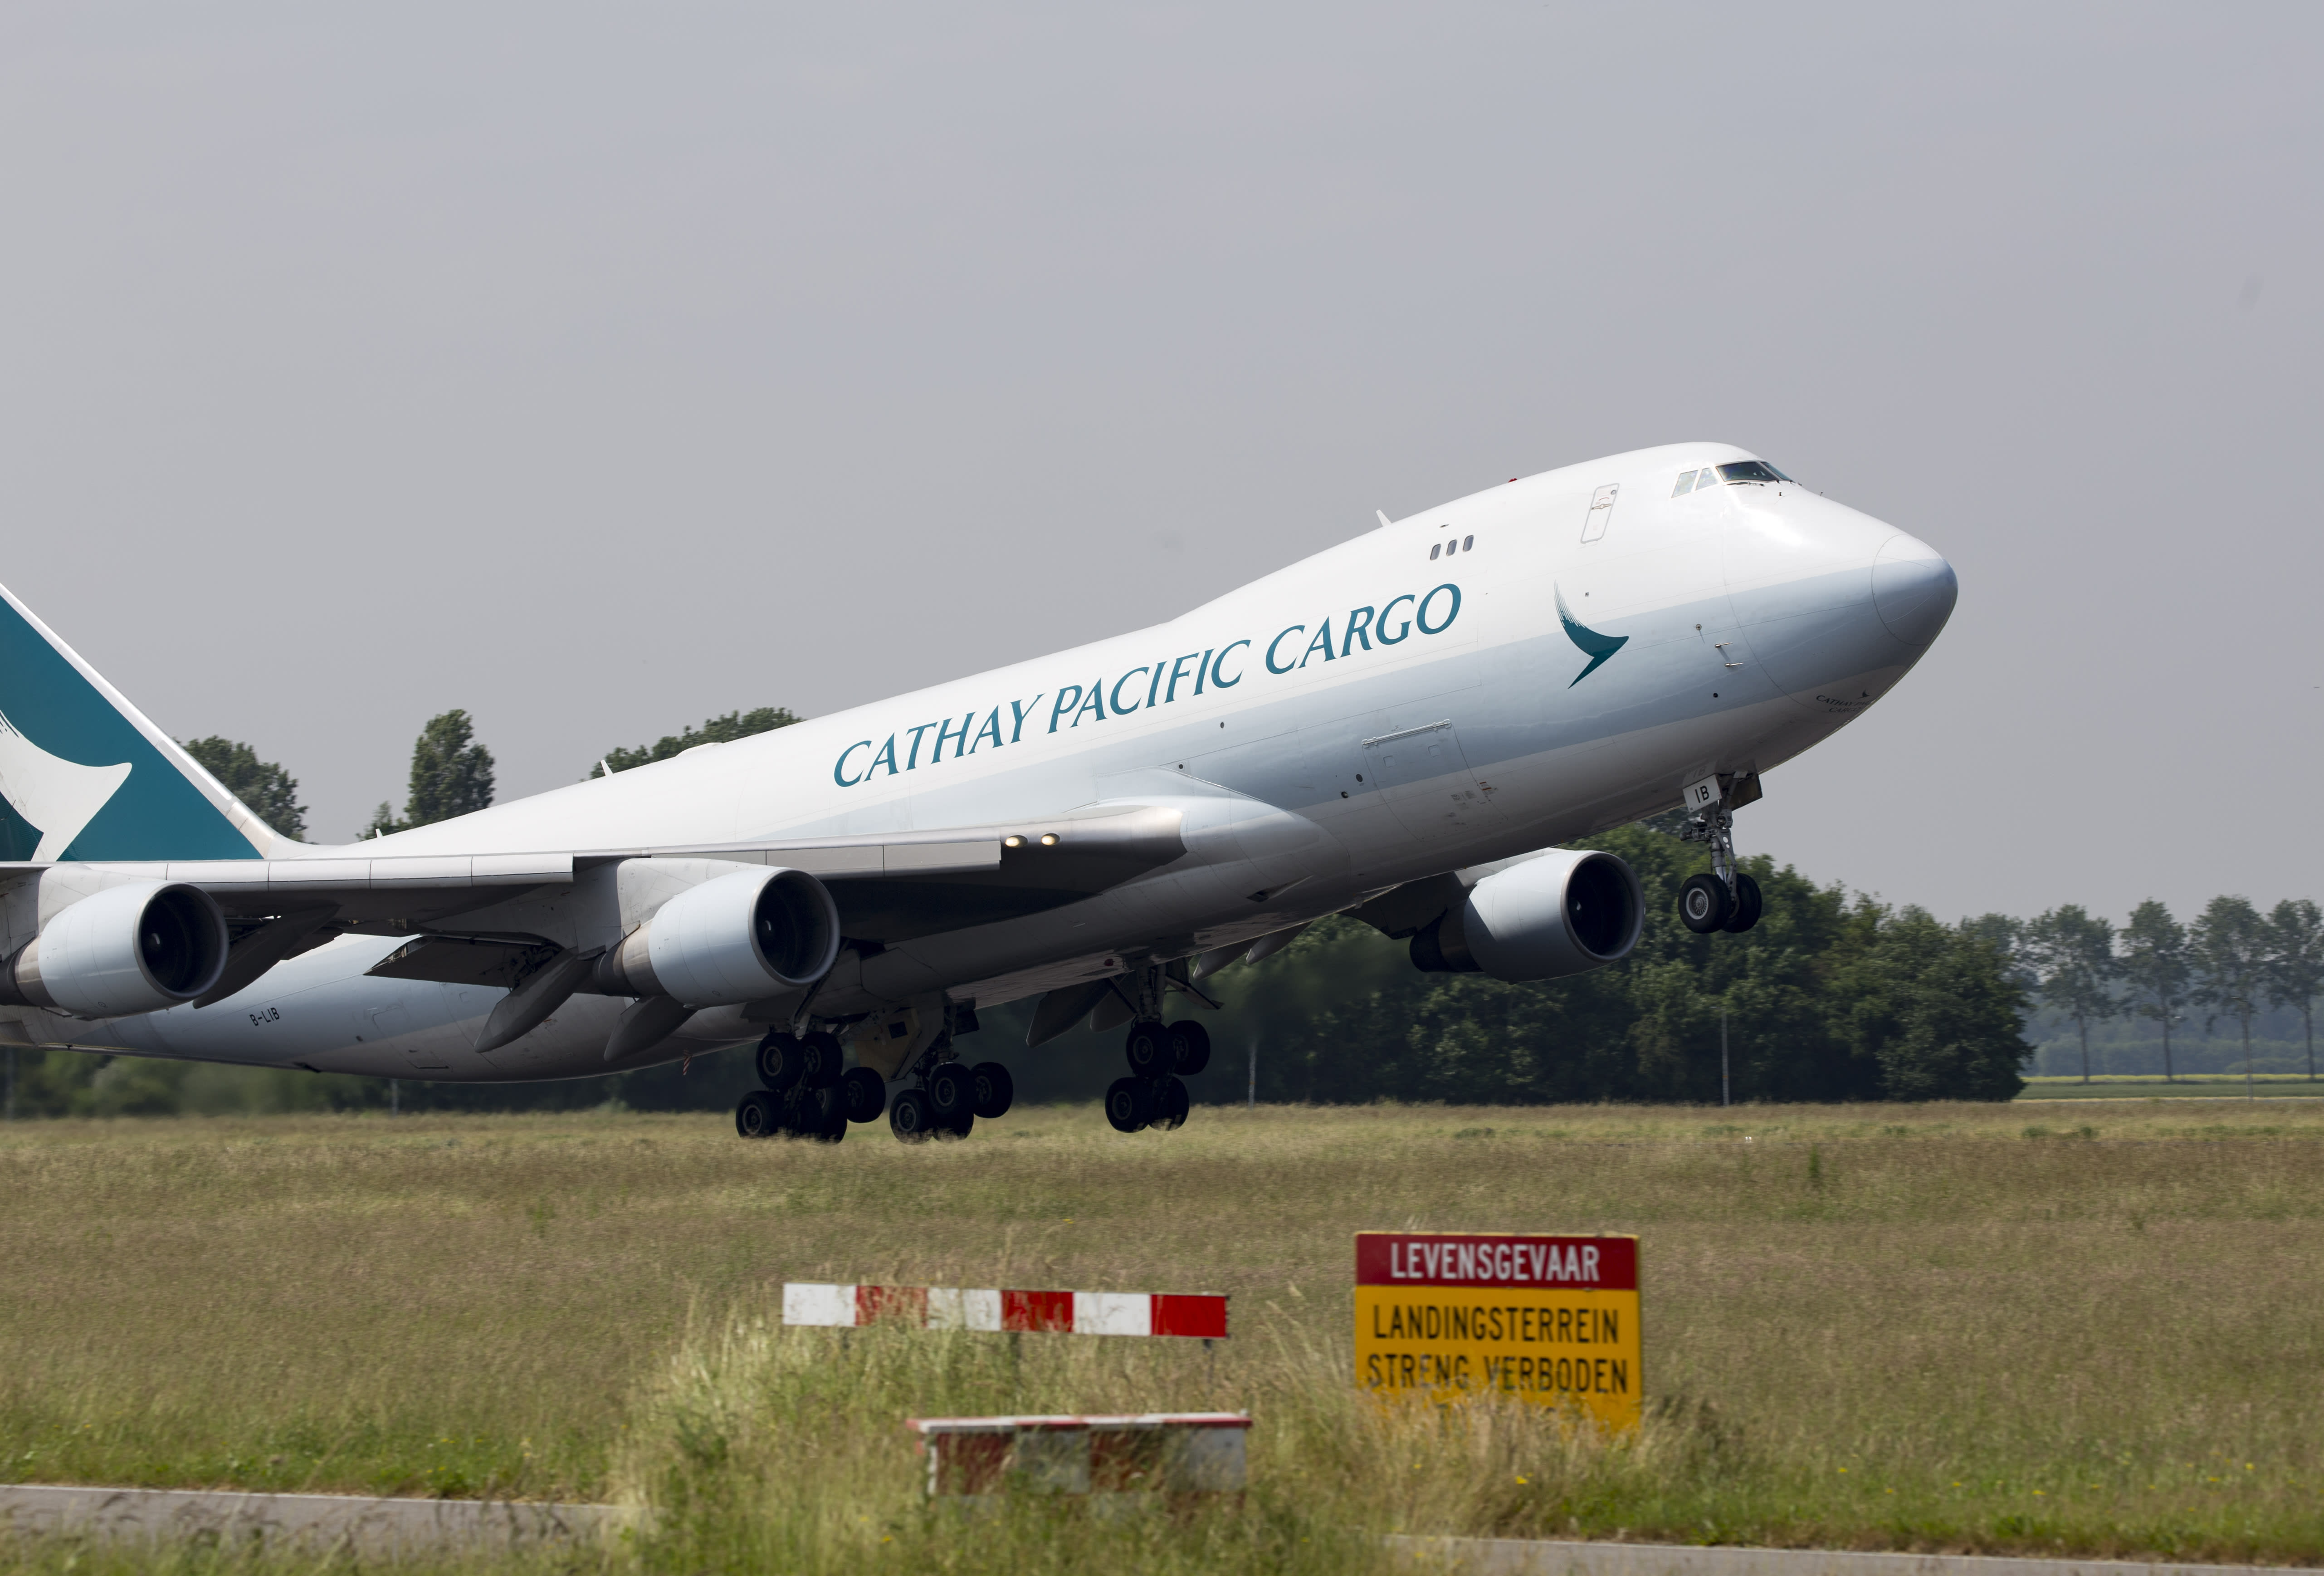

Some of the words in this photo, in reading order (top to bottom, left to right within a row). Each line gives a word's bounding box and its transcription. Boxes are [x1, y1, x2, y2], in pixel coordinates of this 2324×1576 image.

[834, 693, 1046, 788] CATHAY
[1047, 639, 1251, 734] PACIFIC
[1265, 583, 1461, 675] CARGO
[1816, 695, 1853, 706] CATHAY
[249, 1008, 280, 1026] B-LIB
[1391, 1242, 1601, 1282] LEVENSGEVAAR
[1373, 1304, 1619, 1344] LANDINGSTERREIN
[1367, 1353, 1469, 1390] STRENG
[1483, 1355, 1628, 1394] VERBODEN
